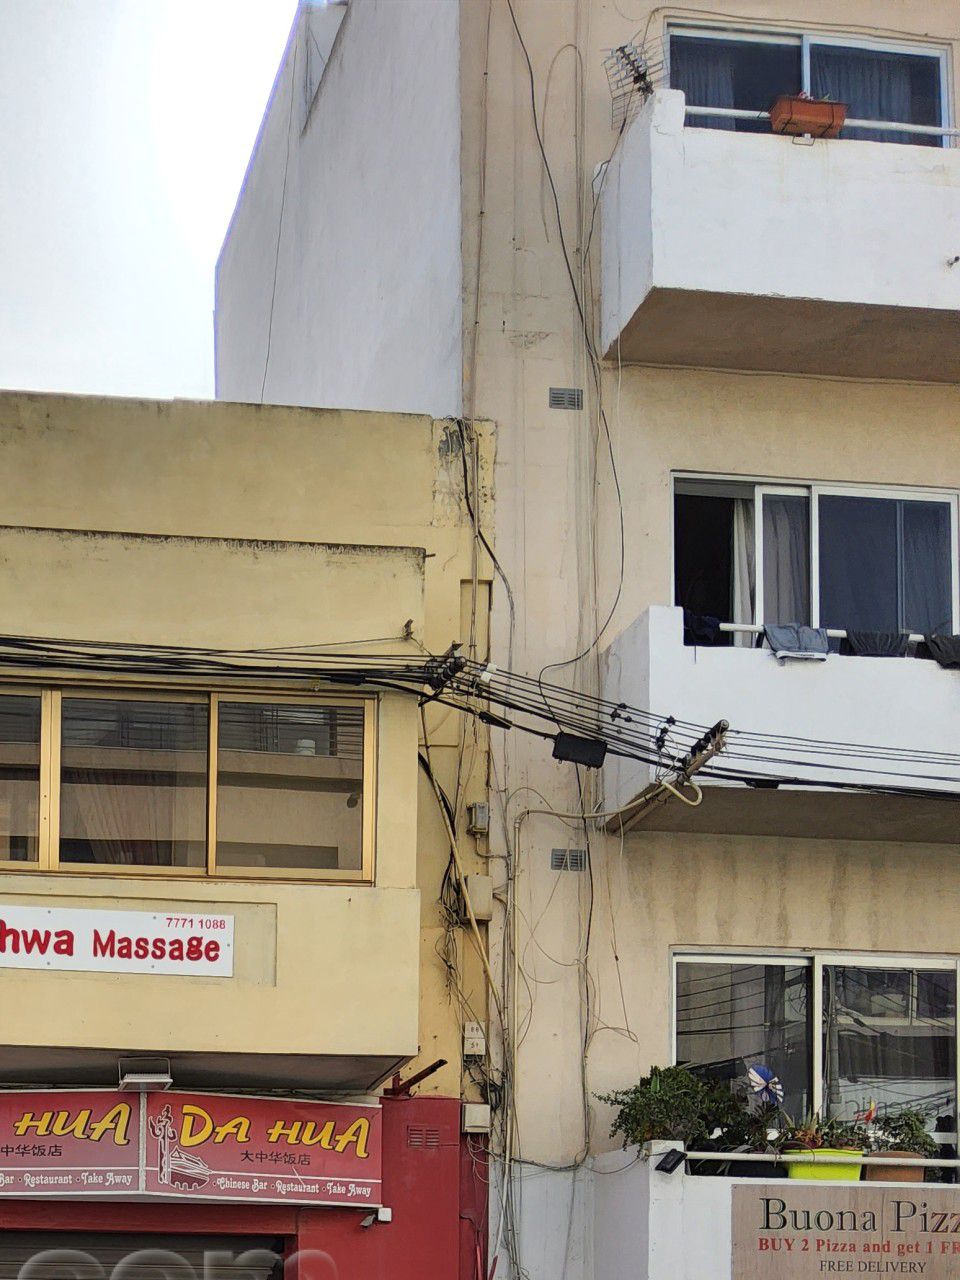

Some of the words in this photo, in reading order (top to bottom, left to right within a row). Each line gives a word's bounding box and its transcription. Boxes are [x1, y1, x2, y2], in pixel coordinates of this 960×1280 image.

[166, 917, 194, 929] 7771
[198, 918, 226, 930] 1088
[92, 929, 221, 962] Massage
[13, 1101, 132, 1146] HUA
[179, 1104, 251, 1148] DA
[266, 1116, 371, 1159] HUA
[240, 1150, 311, 1167] 大中华饭店
[23, 1172, 72, 1187] Restaurant
[81, 1171, 104, 1185] Take
[104, 1172, 133, 1187] Away
[217, 1177, 250, 1190] Chinese
[251, 1178, 267, 1191] Bar
[276, 1180, 320, 1194] Restaurant
[326, 1182, 346, 1195] Take
[347, 1183, 372, 1197] Away
[759, 1198, 877, 1232] Buona
[758, 1238, 796, 1252] BUY
[801, 1238, 809, 1252] 2
[816, 1239, 857, 1253] Pizza
[863, 1240, 891, 1253] and
[897, 1240, 920, 1257] get
[926, 1241, 933, 1253] 1
[820, 1260, 853, 1272] FREE
[857, 1261, 927, 1273] DELIVERY
